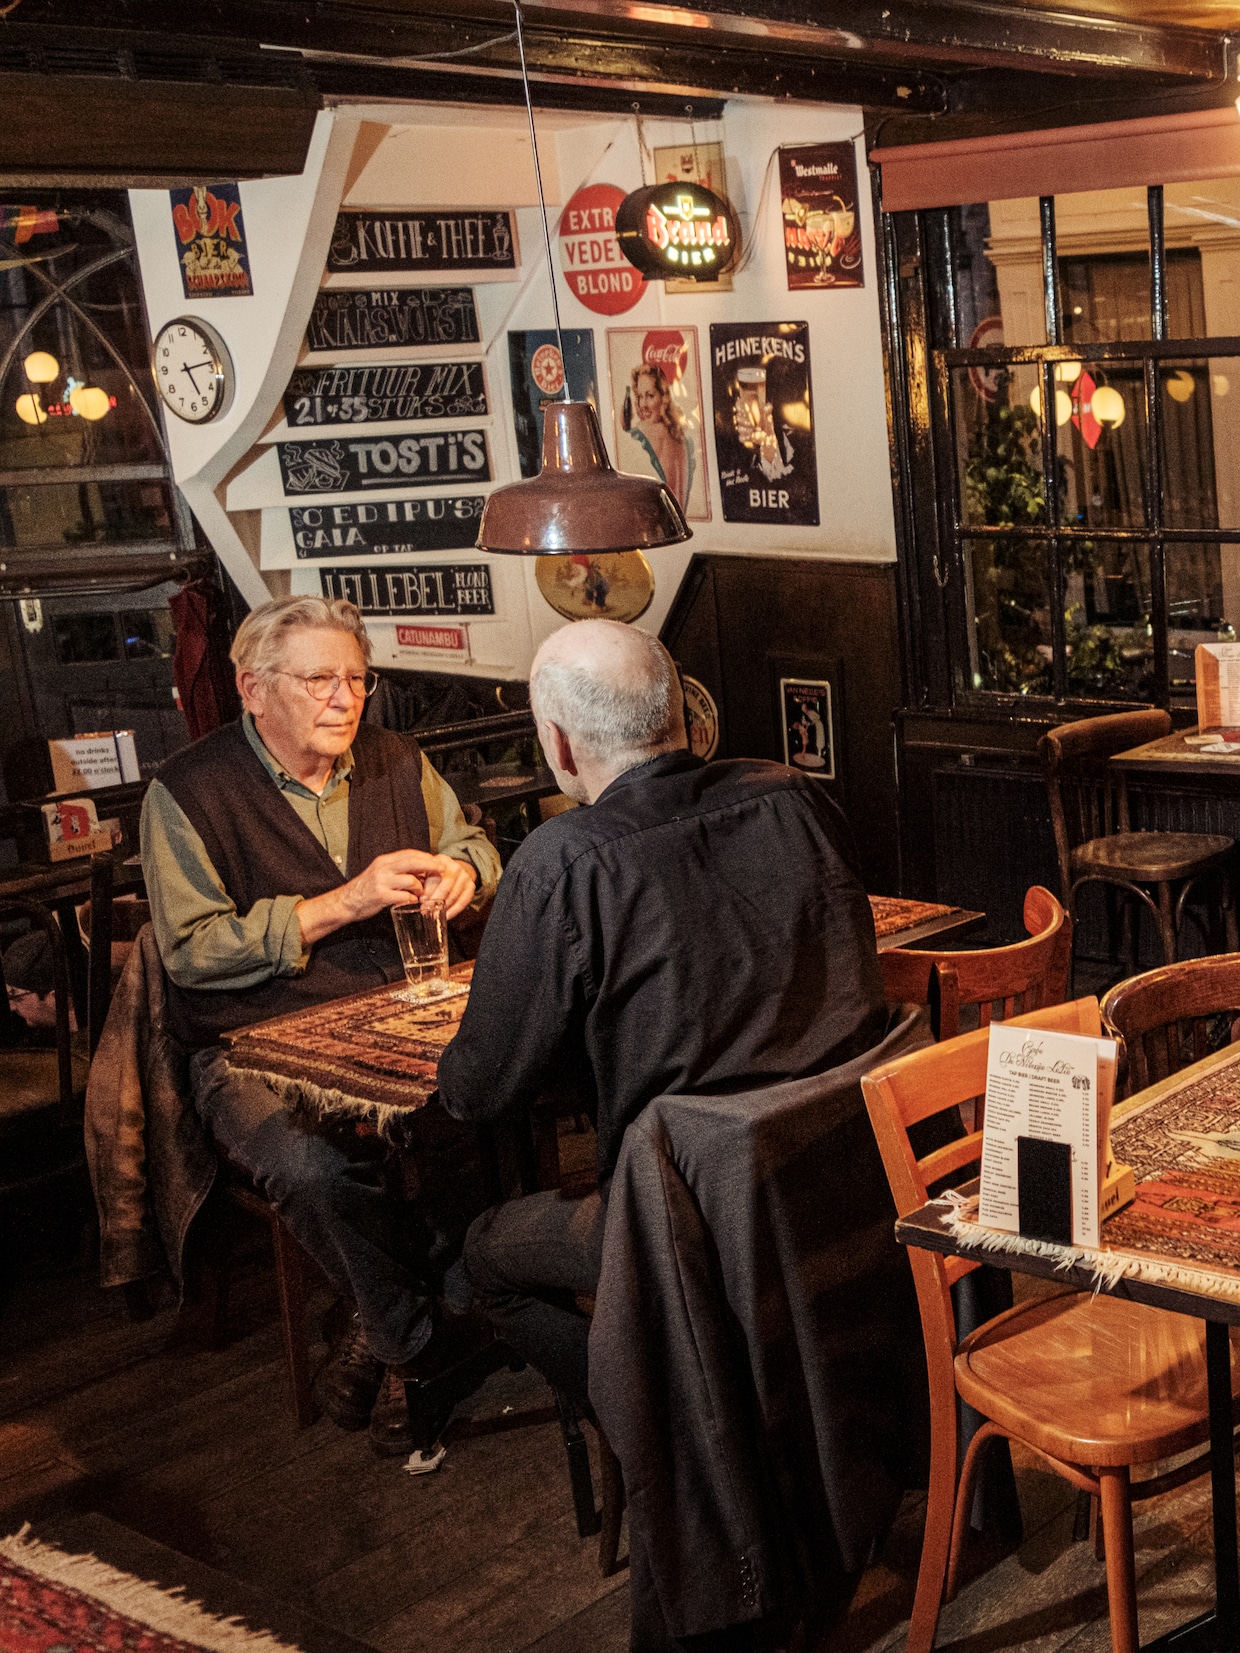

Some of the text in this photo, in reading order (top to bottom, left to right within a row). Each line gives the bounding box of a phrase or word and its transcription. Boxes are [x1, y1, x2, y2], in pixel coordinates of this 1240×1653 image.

[795, 162, 838, 177] Westmalle
[173, 192, 242, 245] BOK
[569, 207, 613, 230] EXTR
[646, 203, 730, 249] Brand
[356, 218, 491, 260] KOFFIE & THEE
[565, 239, 625, 265] VEDET
[667, 246, 715, 265] BIER
[577, 272, 633, 295] BLOND
[371, 291, 400, 306] MIX
[178, 328, 187, 337] 12
[311, 307, 389, 348] KAAS
[162, 348, 169, 357] 10
[715, 336, 805, 366] HEINEKEN'S
[161, 366, 168, 375] 9
[168, 384, 176, 393] 8
[208, 382, 214, 391] 4
[315, 364, 478, 397] FRITUUR MIX
[179, 398, 185, 407] 7
[191, 402, 197, 412] 6
[202, 397, 208, 406] 5
[294, 397, 322, 424] 21
[339, 396, 368, 422] 35
[749, 488, 790, 508] BIER
[296, 527, 366, 549] GAIA
[394, 544, 413, 553] TAP
[455, 571, 489, 588] BLOND
[457, 588, 490, 605] BEER
